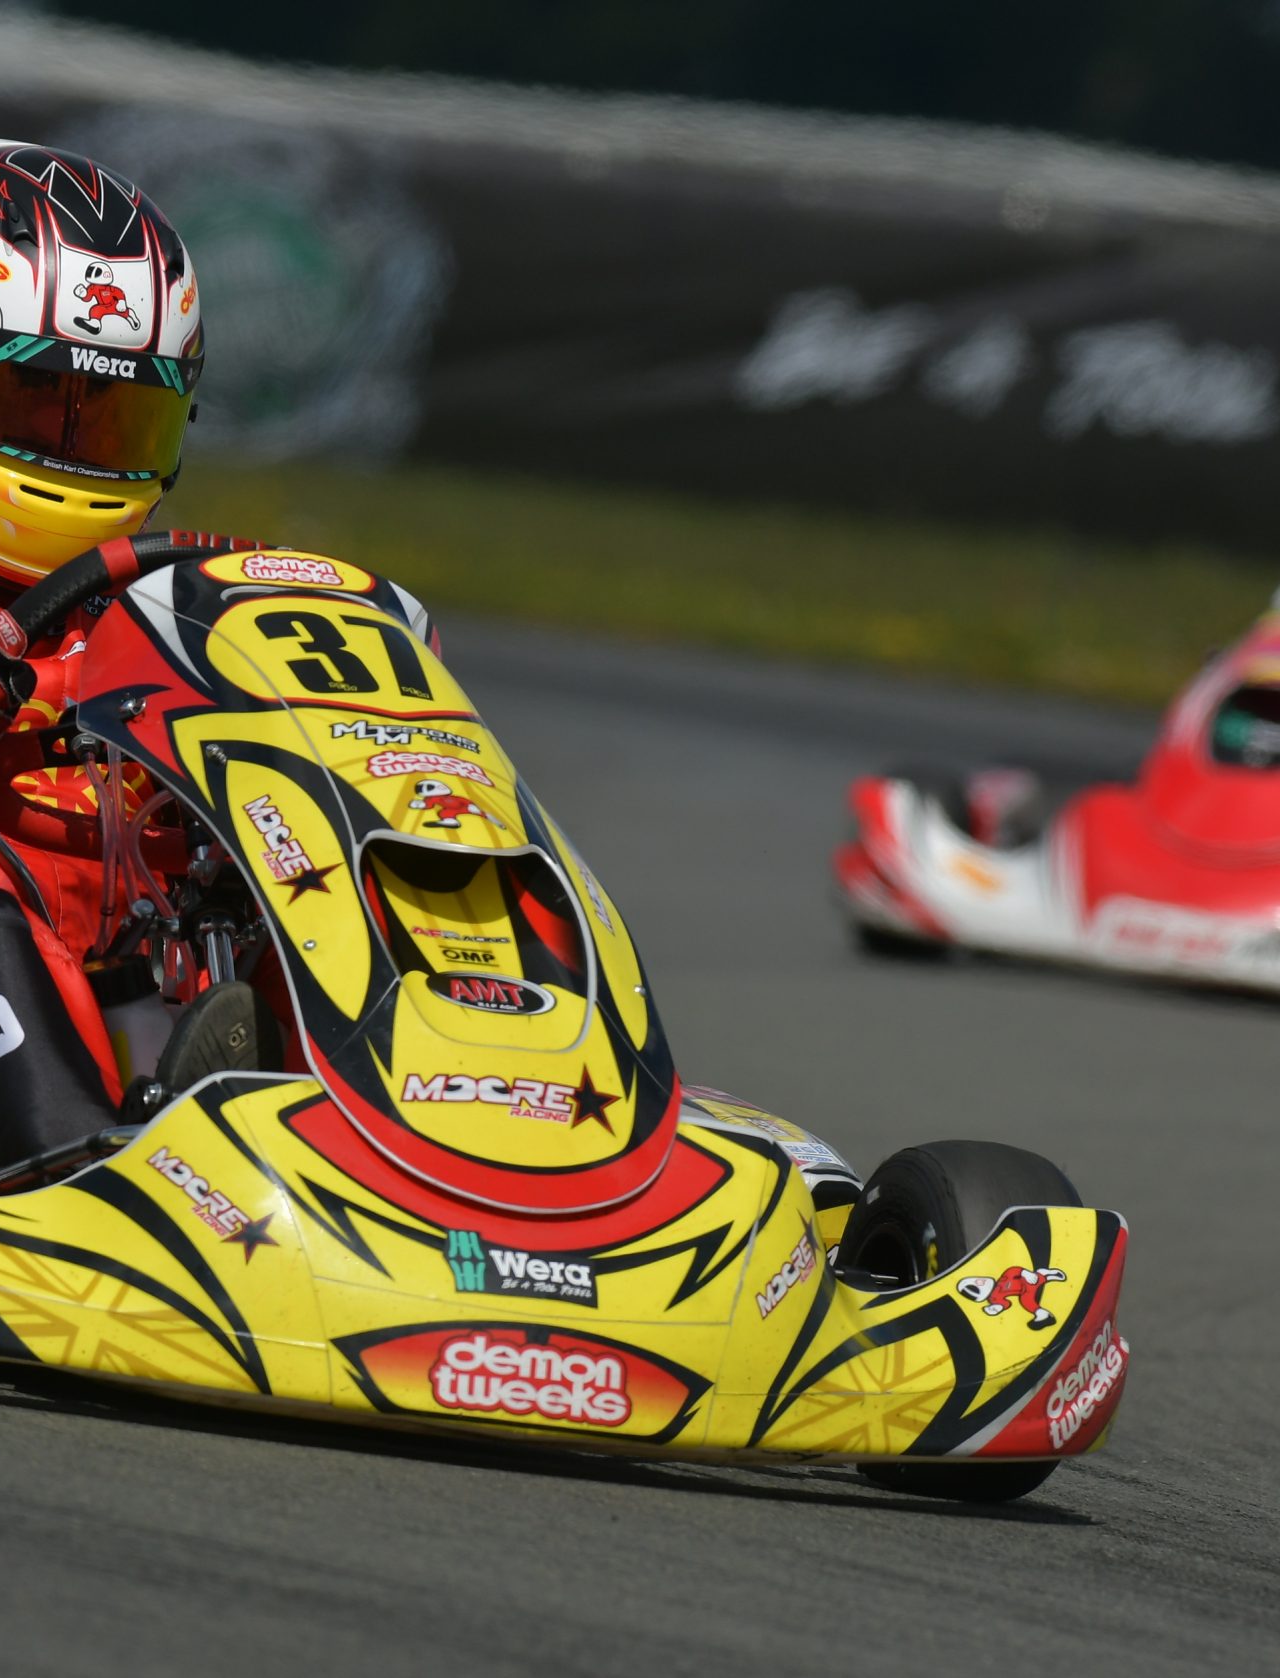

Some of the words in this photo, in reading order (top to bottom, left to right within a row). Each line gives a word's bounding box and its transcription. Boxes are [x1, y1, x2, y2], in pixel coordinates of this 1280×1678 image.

[71, 347, 136, 378] Wera
[43, 460, 63, 470] British
[244, 554, 334, 574] demon
[244, 566, 342, 585] tweeks
[254, 611, 434, 701] 37
[369, 752, 483, 775] demon
[370, 763, 494, 787] tweeks
[442, 949, 495, 963] OMP
[450, 979, 524, 1007] AMT
[510, 1108, 569, 1122] RACING
[489, 1249, 592, 1288] Wera
[444, 1336, 620, 1389] demon
[1047, 1320, 1111, 1418] demon
[435, 1368, 627, 1421] tweeks
[1050, 1345, 1122, 1449] tweeks
